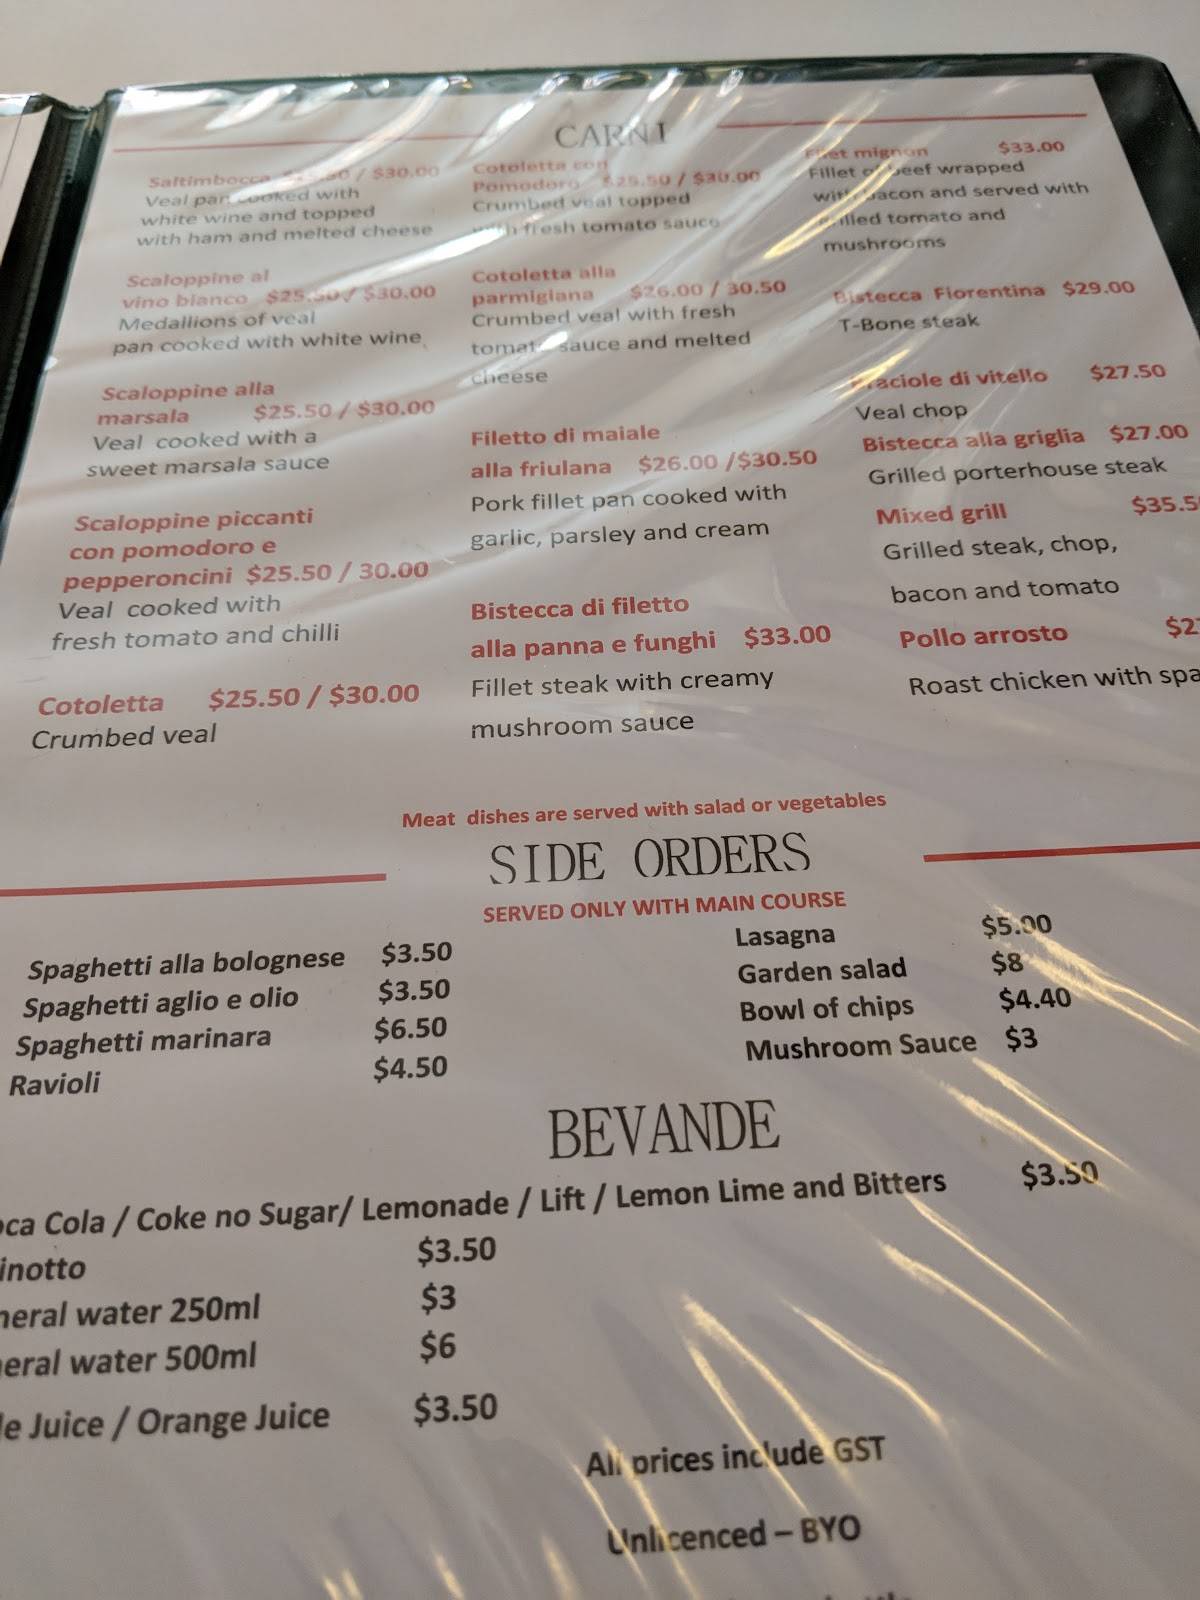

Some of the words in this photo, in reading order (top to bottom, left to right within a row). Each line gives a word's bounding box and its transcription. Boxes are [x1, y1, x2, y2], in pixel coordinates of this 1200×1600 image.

[554, 122, 668, 148] CARNI
[998, 141, 1065, 154] $33.00
[472, 197, 565, 212] Crumbed
[572, 197, 611, 208] veal
[619, 192, 690, 208] topped
[931, 185, 967, 198] and
[973, 183, 1039, 197] served
[1044, 182, 1089, 194] with
[141, 215, 198, 226] white
[205, 214, 252, 222] wine
[259, 209, 296, 221] and
[302, 205, 375, 221] topped
[887, 212, 962, 224] tomato
[969, 207, 1006, 221] and
[137, 234, 181, 246] with
[188, 233, 232, 244] ham
[238, 228, 277, 243] and
[283, 226, 355, 240] melted
[362, 225, 433, 236] cheese
[824, 237, 946, 252] mushrooms
[127, 273, 243, 288] Scaloppine
[251, 270, 269, 282] al
[472, 268, 572, 283] Cotoletta
[580, 266, 615, 278] alla
[472, 289, 593, 308] parmigiana
[631, 285, 702, 300] $26.00
[728, 280, 786, 296] 30.50
[933, 284, 1047, 300] Fiorentina
[1062, 280, 1136, 297] $29.00
[119, 316, 237, 330] Medallions
[243, 312, 266, 327] of
[272, 313, 314, 324] veal
[472, 310, 570, 327] Crumbed
[578, 307, 619, 323] veal
[629, 306, 674, 321] with
[682, 304, 735, 319] fresh
[839, 318, 915, 332] T-Bone
[922, 313, 980, 328] steak
[113, 340, 154, 357] pan
[159, 336, 239, 351] cooked
[247, 335, 294, 348] with
[301, 332, 362, 347] white
[560, 340, 619, 351] sauce
[628, 334, 668, 350] and
[675, 330, 750, 348] melted
[949, 370, 971, 386] di
[975, 368, 1048, 385] vitello
[1089, 364, 1166, 383] $27.50
[102, 384, 229, 402] Scaloppine
[234, 381, 274, 397] alla
[97, 409, 189, 425] marsala
[255, 404, 331, 420] $25.50
[355, 400, 435, 419] $30.00
[855, 403, 905, 421] Veal
[912, 403, 968, 420] chop
[93, 435, 142, 450] Veal
[157, 432, 238, 448] cooked
[248, 430, 297, 446] with
[304, 432, 317, 444] a
[471, 430, 547, 447] Filetto
[553, 427, 575, 444] di
[583, 425, 660, 442] maiale
[862, 436, 958, 453] Bistecca
[966, 432, 1007, 447] alla
[1013, 428, 1086, 449] griglia
[1109, 424, 1190, 444] $27.00
[86, 462, 160, 477] sweet
[161, 456, 256, 475] marsala
[264, 458, 329, 470] sauce
[471, 462, 512, 479] alla
[520, 460, 611, 476] friulana
[639, 455, 717, 473] $26.00
[726, 449, 817, 471] /$30.50
[868, 466, 946, 485] Grilled
[954, 462, 1098, 485] porterhouse
[1104, 457, 1167, 475] steak
[472, 494, 524, 512] Pork
[531, 493, 583, 510] fillet
[593, 494, 634, 511] pan
[643, 486, 727, 506] cooked
[734, 483, 787, 502] with
[75, 513, 210, 534] Scaloppine
[217, 508, 313, 531] piccanti
[876, 505, 954, 525] Mixed
[960, 502, 1008, 525] grill
[471, 530, 541, 552] garlic,
[551, 526, 636, 548] parsley
[644, 522, 687, 541] and
[695, 522, 770, 539] cream
[69, 547, 114, 560] con
[122, 539, 254, 563] pomodoro
[261, 540, 276, 554] e
[62, 567, 232, 593] pepperoncini
[247, 564, 331, 585] $25.50
[360, 562, 430, 580] 30.00
[890, 585, 968, 604] bacon
[975, 580, 1021, 600] and
[1027, 578, 1120, 597] tomato
[471, 602, 574, 621] Bistecca
[581, 598, 605, 616] di
[611, 596, 689, 615] filetto
[52, 631, 116, 651] fresh
[125, 630, 218, 648] tomato
[226, 625, 273, 644] and
[282, 623, 339, 643] chilli
[899, 627, 966, 649] Pollo
[973, 625, 1069, 645] arrosto
[31, 725, 155, 750] Crumbed
[163, 722, 217, 744] veal
[471, 717, 612, 739] mushroom
[621, 715, 694, 733] sauce
[402, 812, 456, 828] Meat
[467, 808, 530, 825] dishes
[535, 809, 567, 823] are
[573, 802, 639, 821] served
[644, 800, 689, 817] with
[694, 797, 745, 815] salad
[751, 800, 773, 812] or
[777, 792, 887, 814] vegetables
[490, 841, 605, 885] SIDE
[634, 832, 811, 878] ORDERS
[483, 904, 564, 923] SERVED
[570, 900, 626, 919] ONLY
[632, 898, 690, 916] WITH
[695, 895, 755, 913] MAIN
[760, 891, 847, 910] COURSE
[27, 955, 153, 985] Spaghetti
[159, 952, 205, 975] alla
[213, 950, 345, 975] bolognese
[381, 941, 453, 968] $3.50
[740, 998, 805, 1022] Bowl
[813, 996, 839, 1019] of
[847, 995, 915, 1021] chips
[999, 987, 1072, 1014] $4.40
[9, 1071, 101, 1097] Ravioli
[373, 1055, 448, 1084] $4.50
[548, 1099, 780, 1160] BEVANDE
[616, 1184, 710, 1209] Lemon
[718, 1178, 785, 1203] Lime
[793, 1172, 845, 1200] and
[853, 1171, 947, 1196] Bitters
[76, 1301, 163, 1327] water
[169, 1292, 261, 1323] 250ml
[421, 1282, 456, 1316] $3
[137, 1407, 248, 1440] Orange
[254, 1401, 330, 1431] Juice
[414, 1392, 498, 1428] $3.50
[833, 1435, 886, 1463] GST
[800, 1514, 862, 1544] BYO
